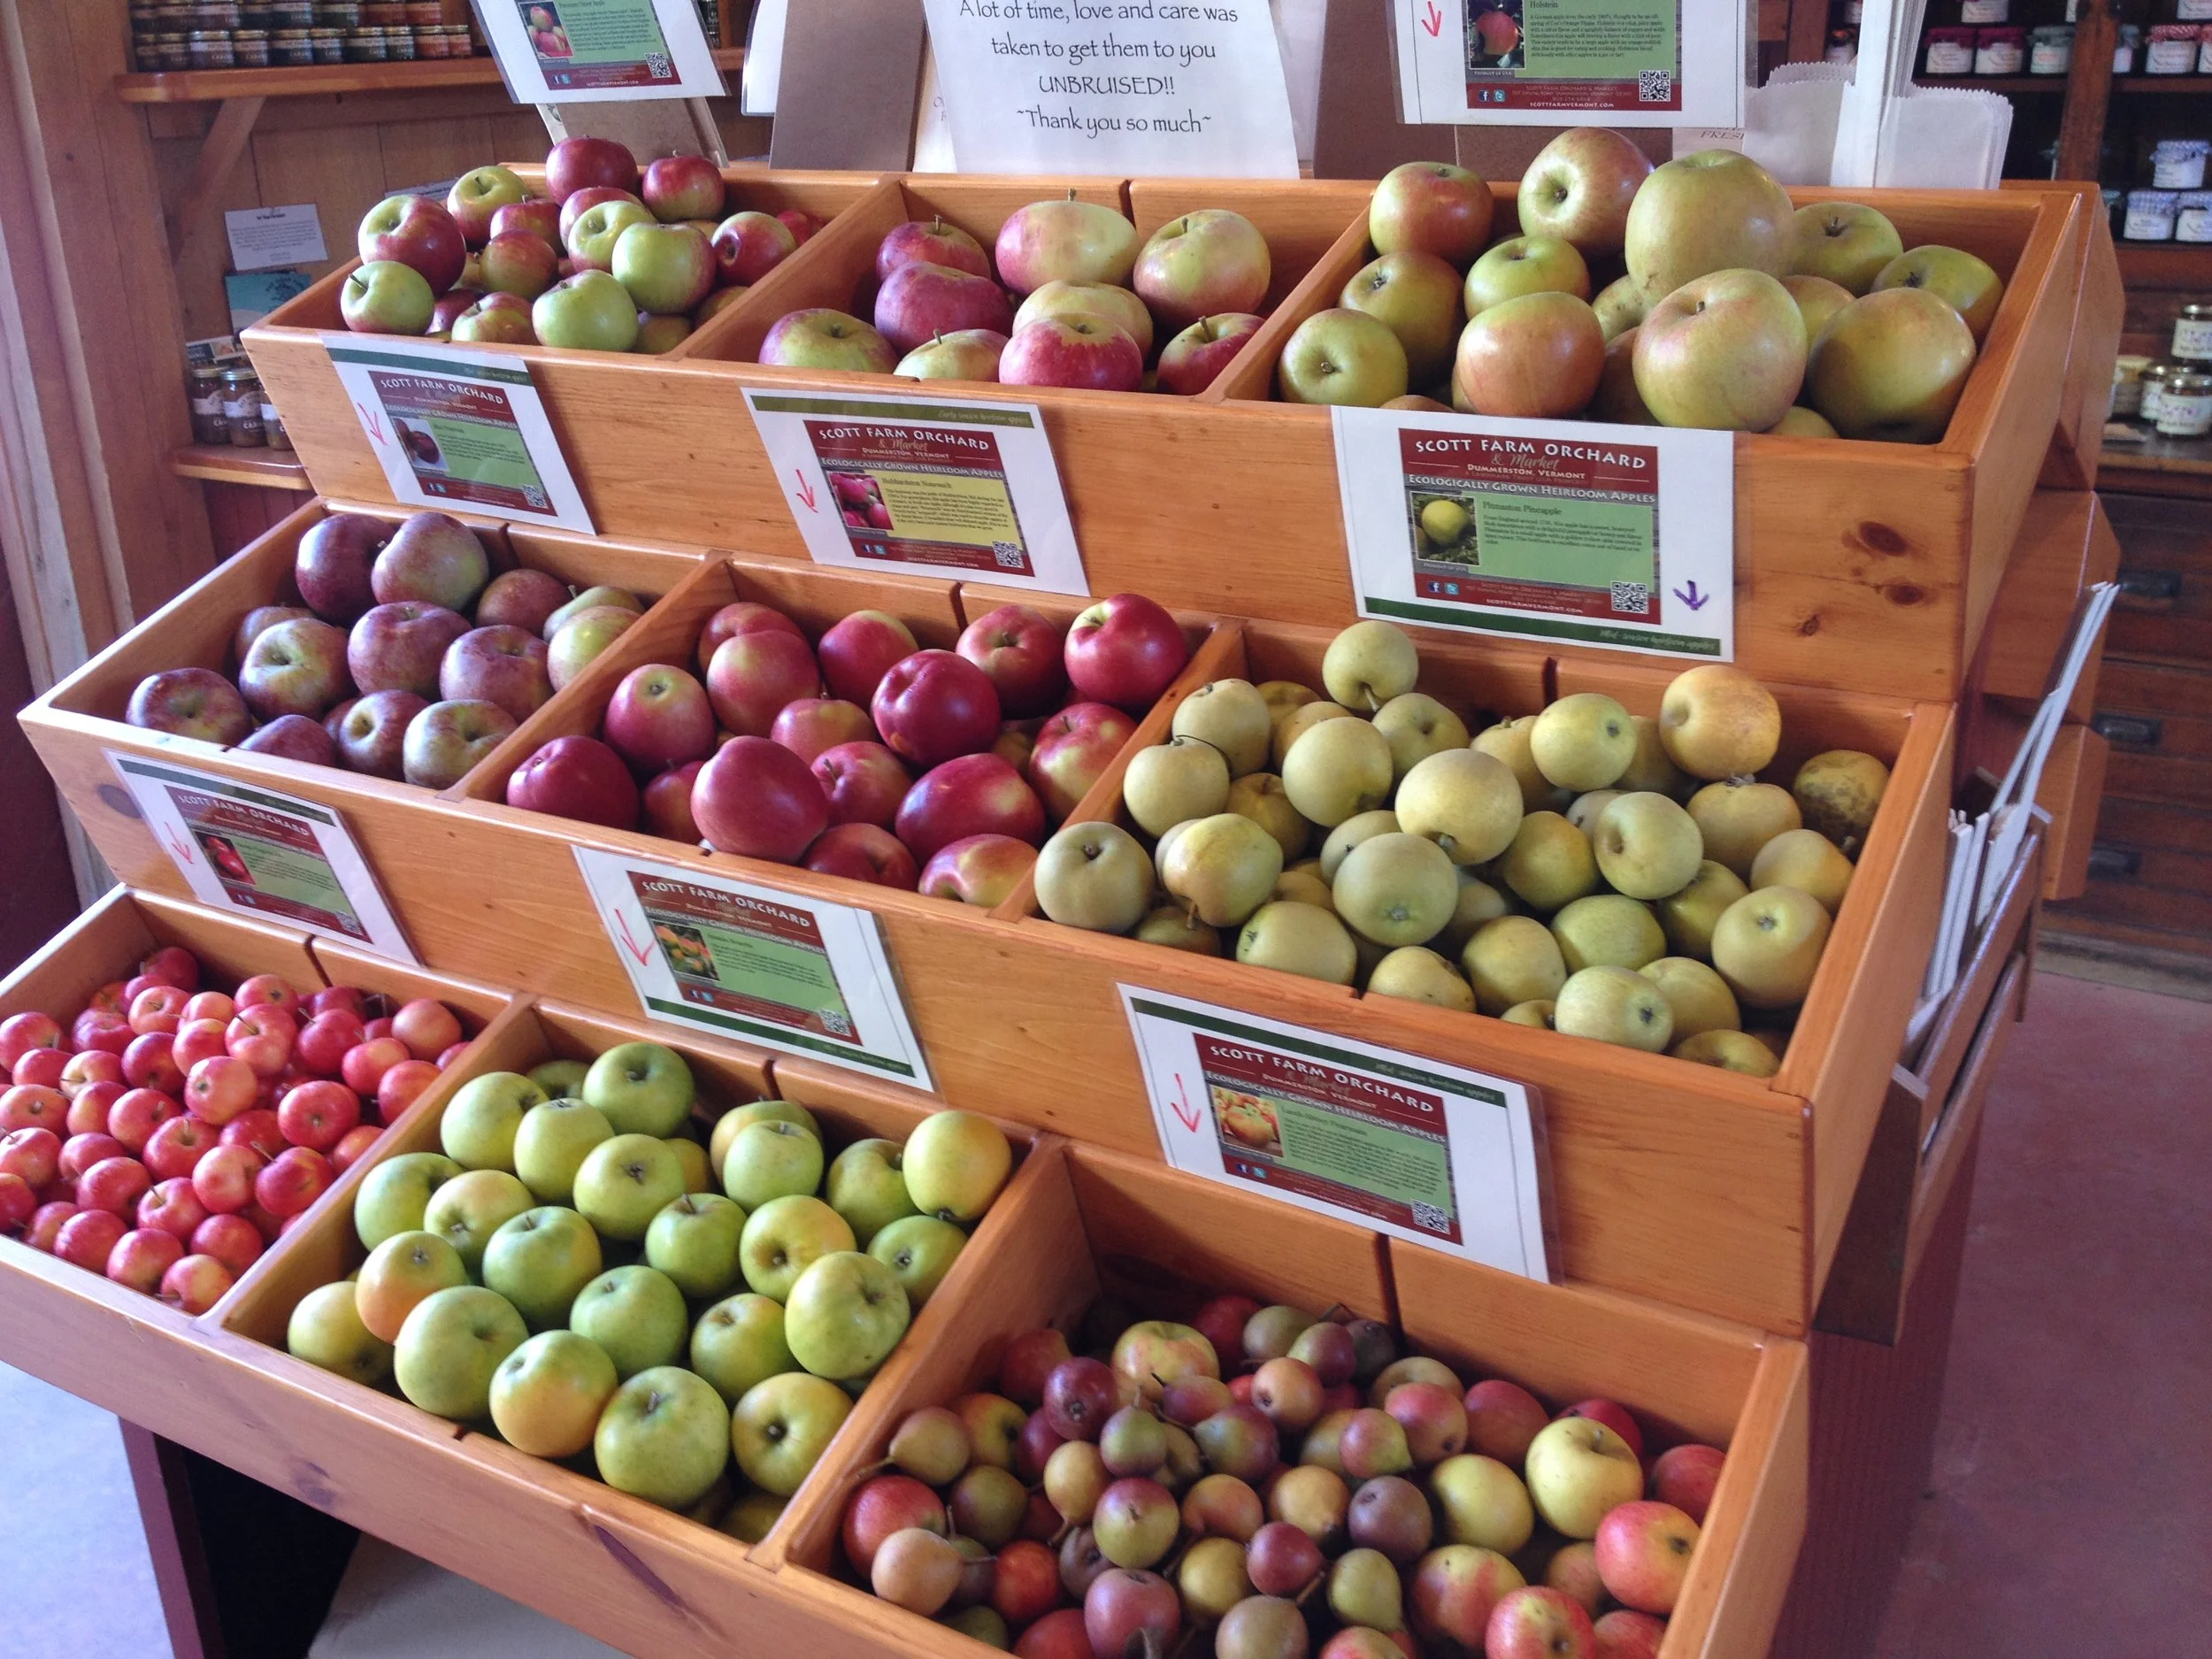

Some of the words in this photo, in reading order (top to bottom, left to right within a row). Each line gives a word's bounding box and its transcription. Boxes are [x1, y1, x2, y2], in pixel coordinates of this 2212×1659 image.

[960, 0, 974, 16] A
[976, 0, 999, 19] lot
[1003, 0, 1022, 19] of
[1026, 1, 1070, 24] time,
[1074, 0, 1112, 19] love
[1118, 0, 1153, 19] and
[1159, 4, 1200, 19] care
[1203, 7, 1238, 23] was
[991, 32, 1041, 56] taken
[1044, 40, 1064, 57] to
[1068, 40, 1098, 65] get
[1102, 33, 1149, 58] them
[1153, 41, 1174, 58] to
[1179, 44, 1216, 67] you
[1039, 75, 1175, 96] UNBRUISED!!
[1087, 117, 1121, 140] you
[1125, 117, 1148, 132] so
[380, 378, 412, 389] SCOTT
[414, 379, 445, 390] FARM
[448, 383, 503, 404] ORCHARD
[819, 426, 861, 440] SCOTT
[866, 427, 908, 440] FARM
[913, 431, 989, 449] ORCHARD
[1416, 439, 1472, 452] SCOTT
[1480, 440, 1535, 454] FARM
[1544, 443, 1647, 469] ORCHARD
[1491, 453, 1503, 465] &
[1509, 453, 1560, 471] Market
[821, 457, 883, 470] ECOLOGICALLY
[884, 462, 919, 472] GROWN
[921, 465, 970, 475] HEIRLOOM
[972, 468, 1005, 479] APPLES
[1538, 469, 1586, 480] VERMONT
[1409, 474, 1488, 490] ECOLOGICALLY
[1492, 481, 1538, 495] GROWN
[1541, 486, 1607, 499] HEIRLOOM
[1610, 491, 1655, 503] APPLES
[1523, 504, 1563, 516] Pineapple
[177, 795, 211, 807] SCOTT
[642, 881, 685, 894] SCOTT
[689, 884, 730, 902] FARM
[735, 897, 810, 927] ORCHARD
[1210, 1046, 1264, 1064] SCOTT
[1273, 1056, 1327, 1079] FARM
[1334, 1072, 1434, 1112] ORCHARD
[1206, 1071, 1284, 1097] ECOLOGICALLY
[1288, 1092, 1333, 1111] GROWN
[1334, 1102, 1400, 1129] HEIRLOOM
[1402, 1124, 1446, 1144] APPLES
